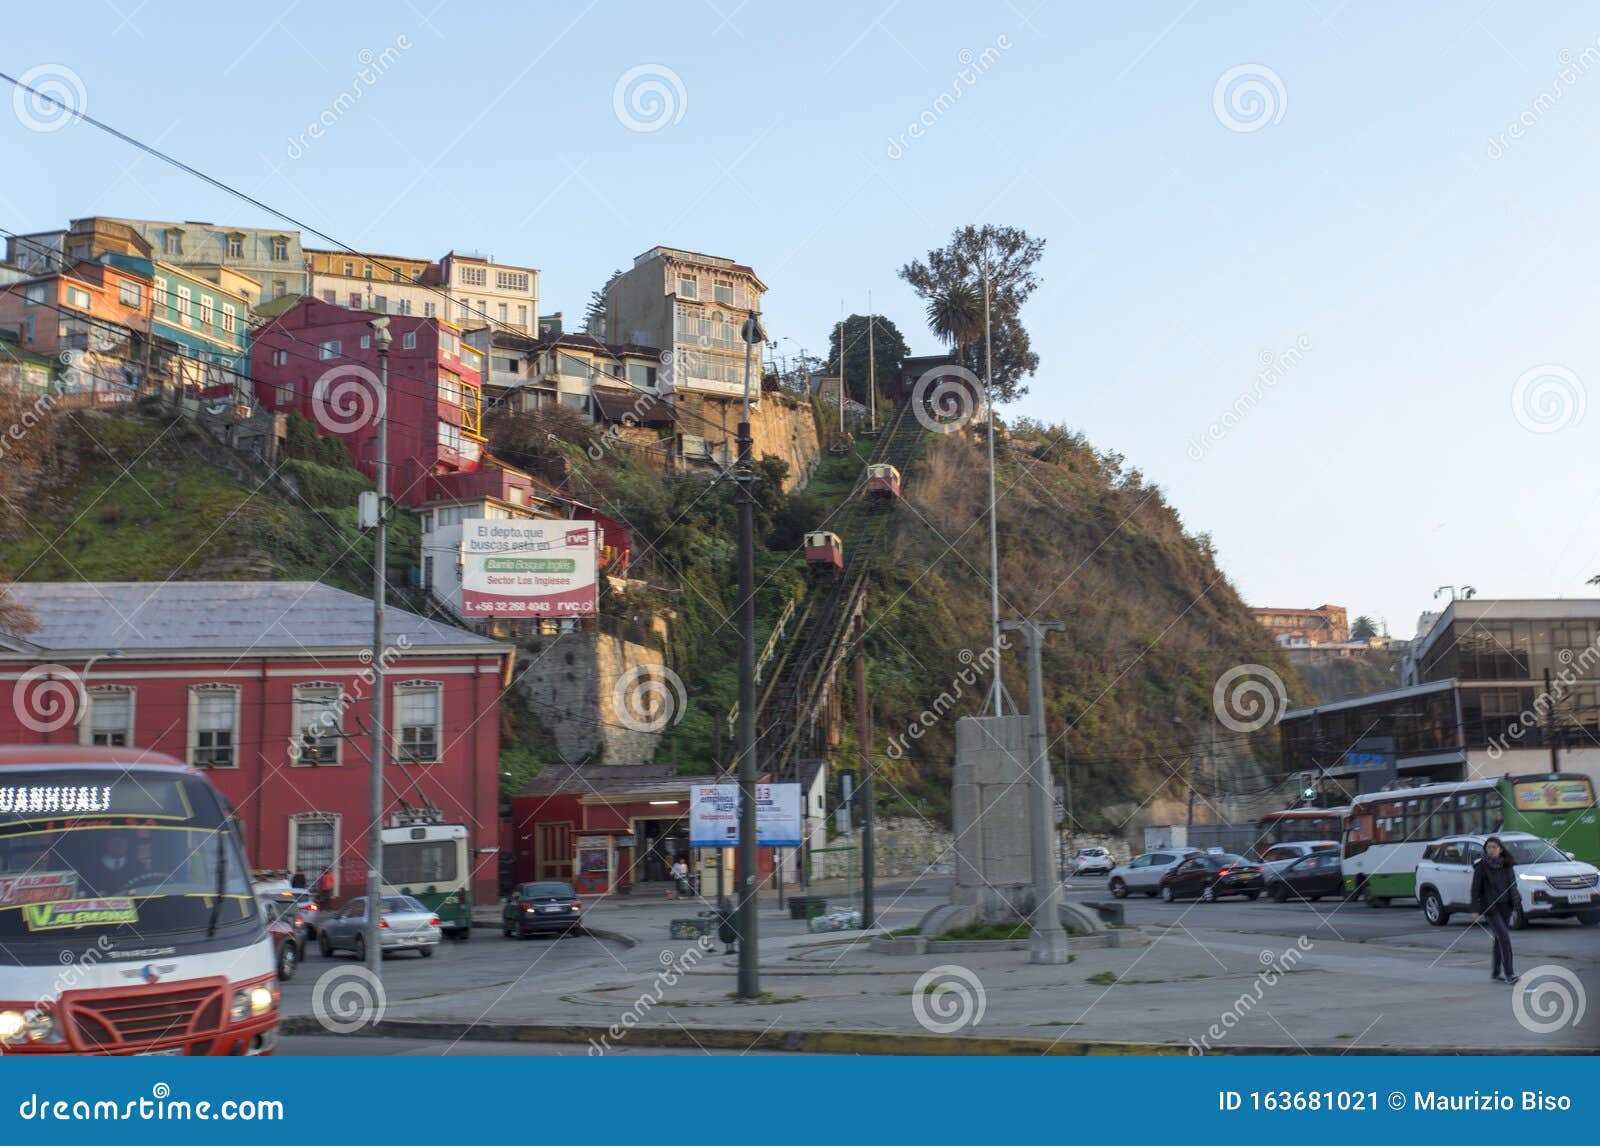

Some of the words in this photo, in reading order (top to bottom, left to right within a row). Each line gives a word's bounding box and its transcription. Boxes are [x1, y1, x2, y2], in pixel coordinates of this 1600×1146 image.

[524, 528, 545, 539] que
[567, 534, 588, 544] rvc
[471, 539, 509, 550] buscas
[536, 542, 550, 551] en
[487, 576, 514, 585] Sector
[517, 576, 532, 585] Los
[534, 576, 570, 586] Ingleses
